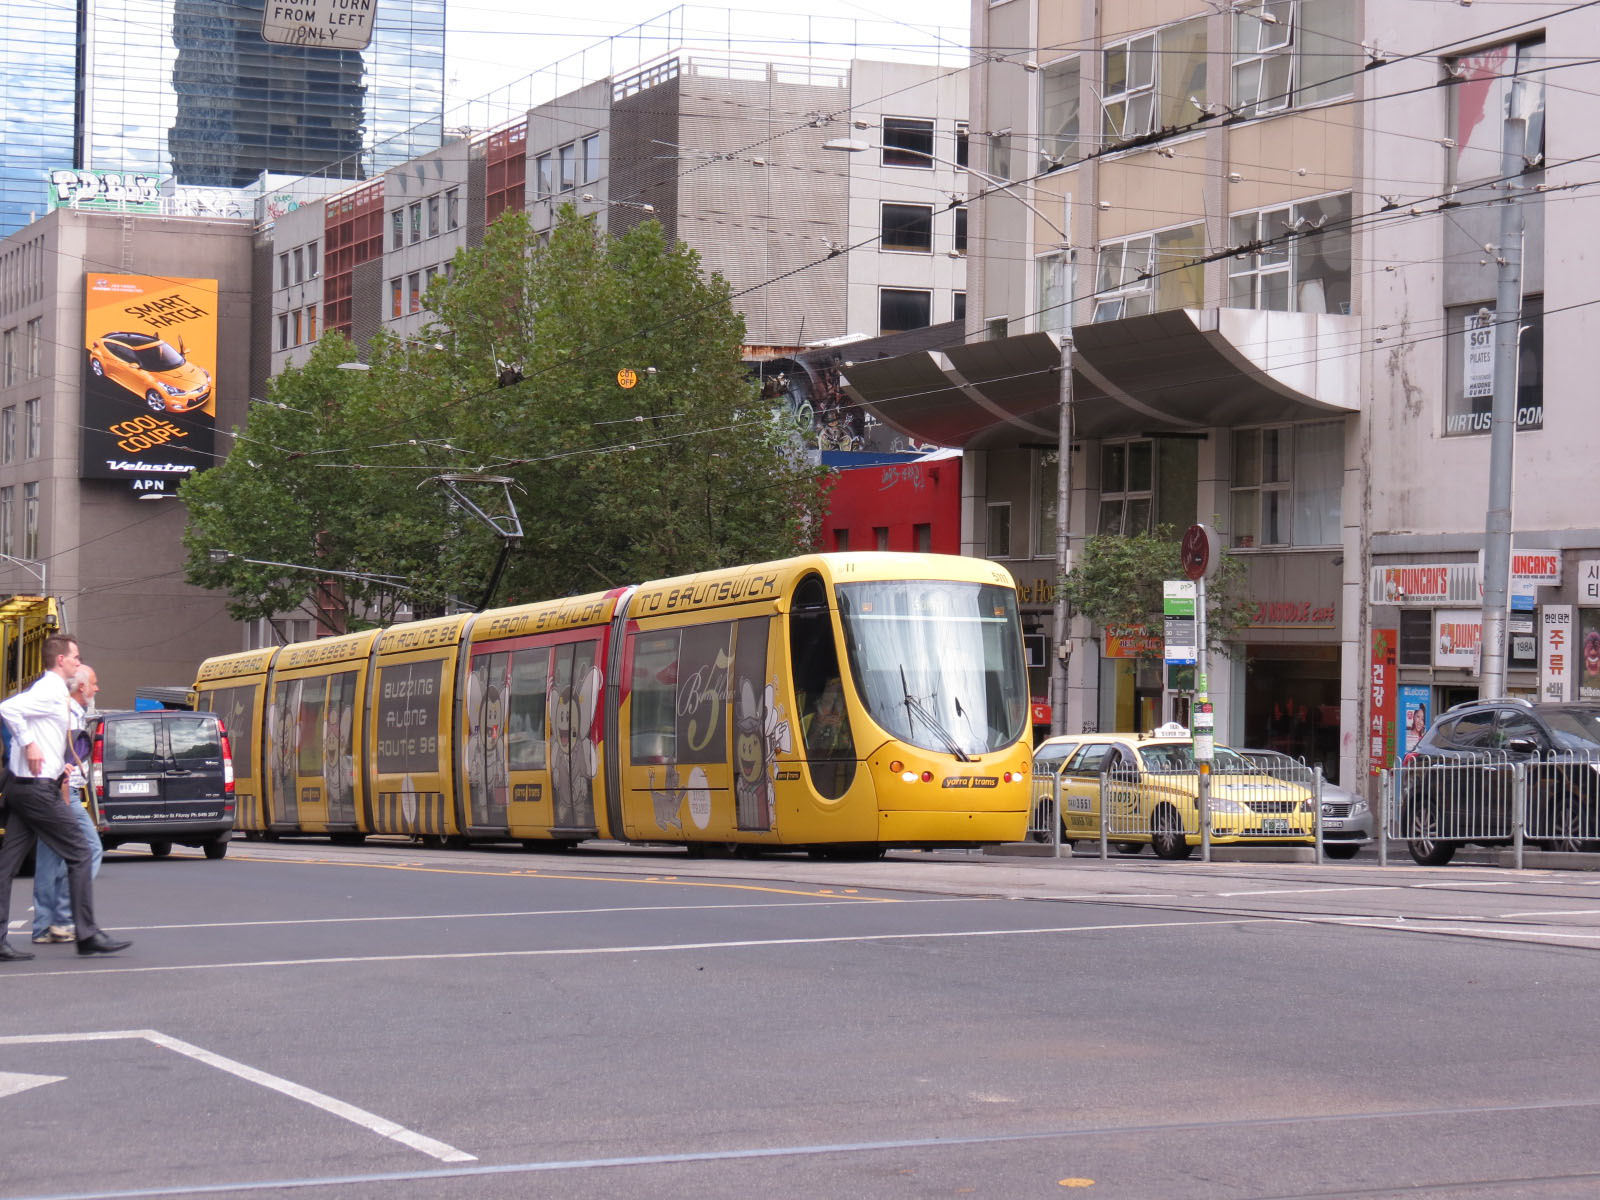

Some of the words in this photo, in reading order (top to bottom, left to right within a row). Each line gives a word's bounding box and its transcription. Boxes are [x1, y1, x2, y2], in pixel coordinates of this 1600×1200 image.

[331, 0, 371, 11] TURN
[274, 7, 316, 23] FROM
[328, 13, 366, 26] LEFT
[297, 26, 338, 40] ONLY
[124, 294, 191, 319] SMART
[143, 305, 209, 328] HATCH
[1470, 330, 1491, 347] SGT
[1469, 351, 1491, 364] PILATES
[619, 370, 635, 378] CUT
[109, 414, 170, 437] COOL
[1446, 412, 1492, 432] VIRTUS
[117, 424, 189, 453] COUPE
[106, 460, 197, 473] Veloster
[133, 479, 165, 491] APN
[1512, 554, 1557, 575] UNCAN'S
[1401, 567, 1448, 595] DUNCAN'S
[641, 592, 663, 613] TO
[667, 573, 778, 609] BRUNSWICK
[488, 615, 529, 636] FROM
[378, 635, 395, 652] ON
[397, 628, 438, 648] ROUTE
[439, 625, 458, 642] 96
[1516, 641, 1534, 653] 198A
[384, 678, 434, 699] BUZZING
[386, 708, 428, 728] ALONG
[378, 739, 416, 757] ROUTE
[419, 736, 437, 753] 96
[946, 778, 968, 788] yarra
[974, 777, 996, 786] trams
